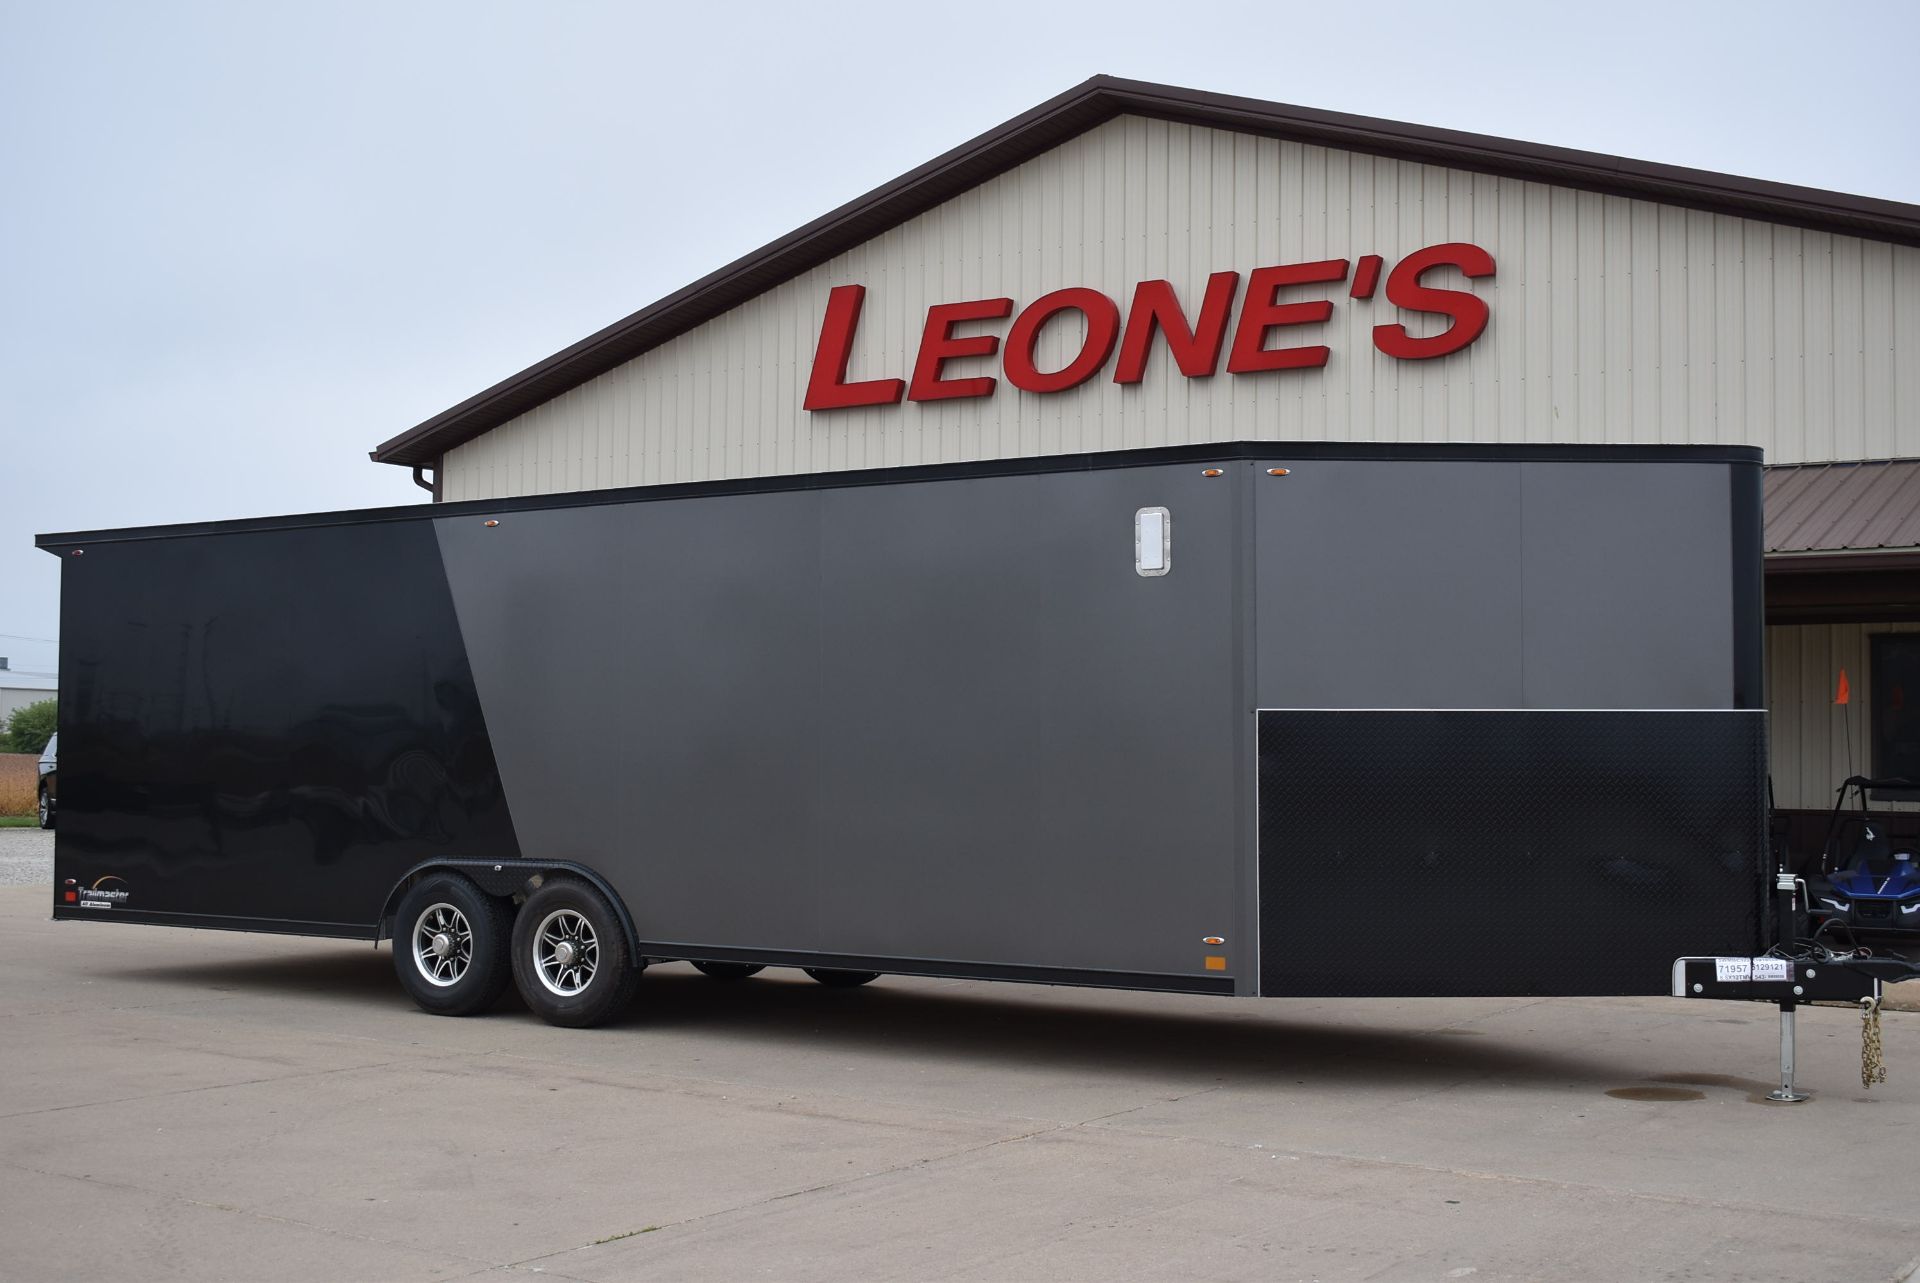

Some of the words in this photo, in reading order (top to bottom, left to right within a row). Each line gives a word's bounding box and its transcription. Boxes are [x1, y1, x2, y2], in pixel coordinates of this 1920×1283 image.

[803, 242, 1496, 411] LEONE'S
[78, 886, 129, 900] Trailmaster
[1718, 964, 1748, 973] 71957
